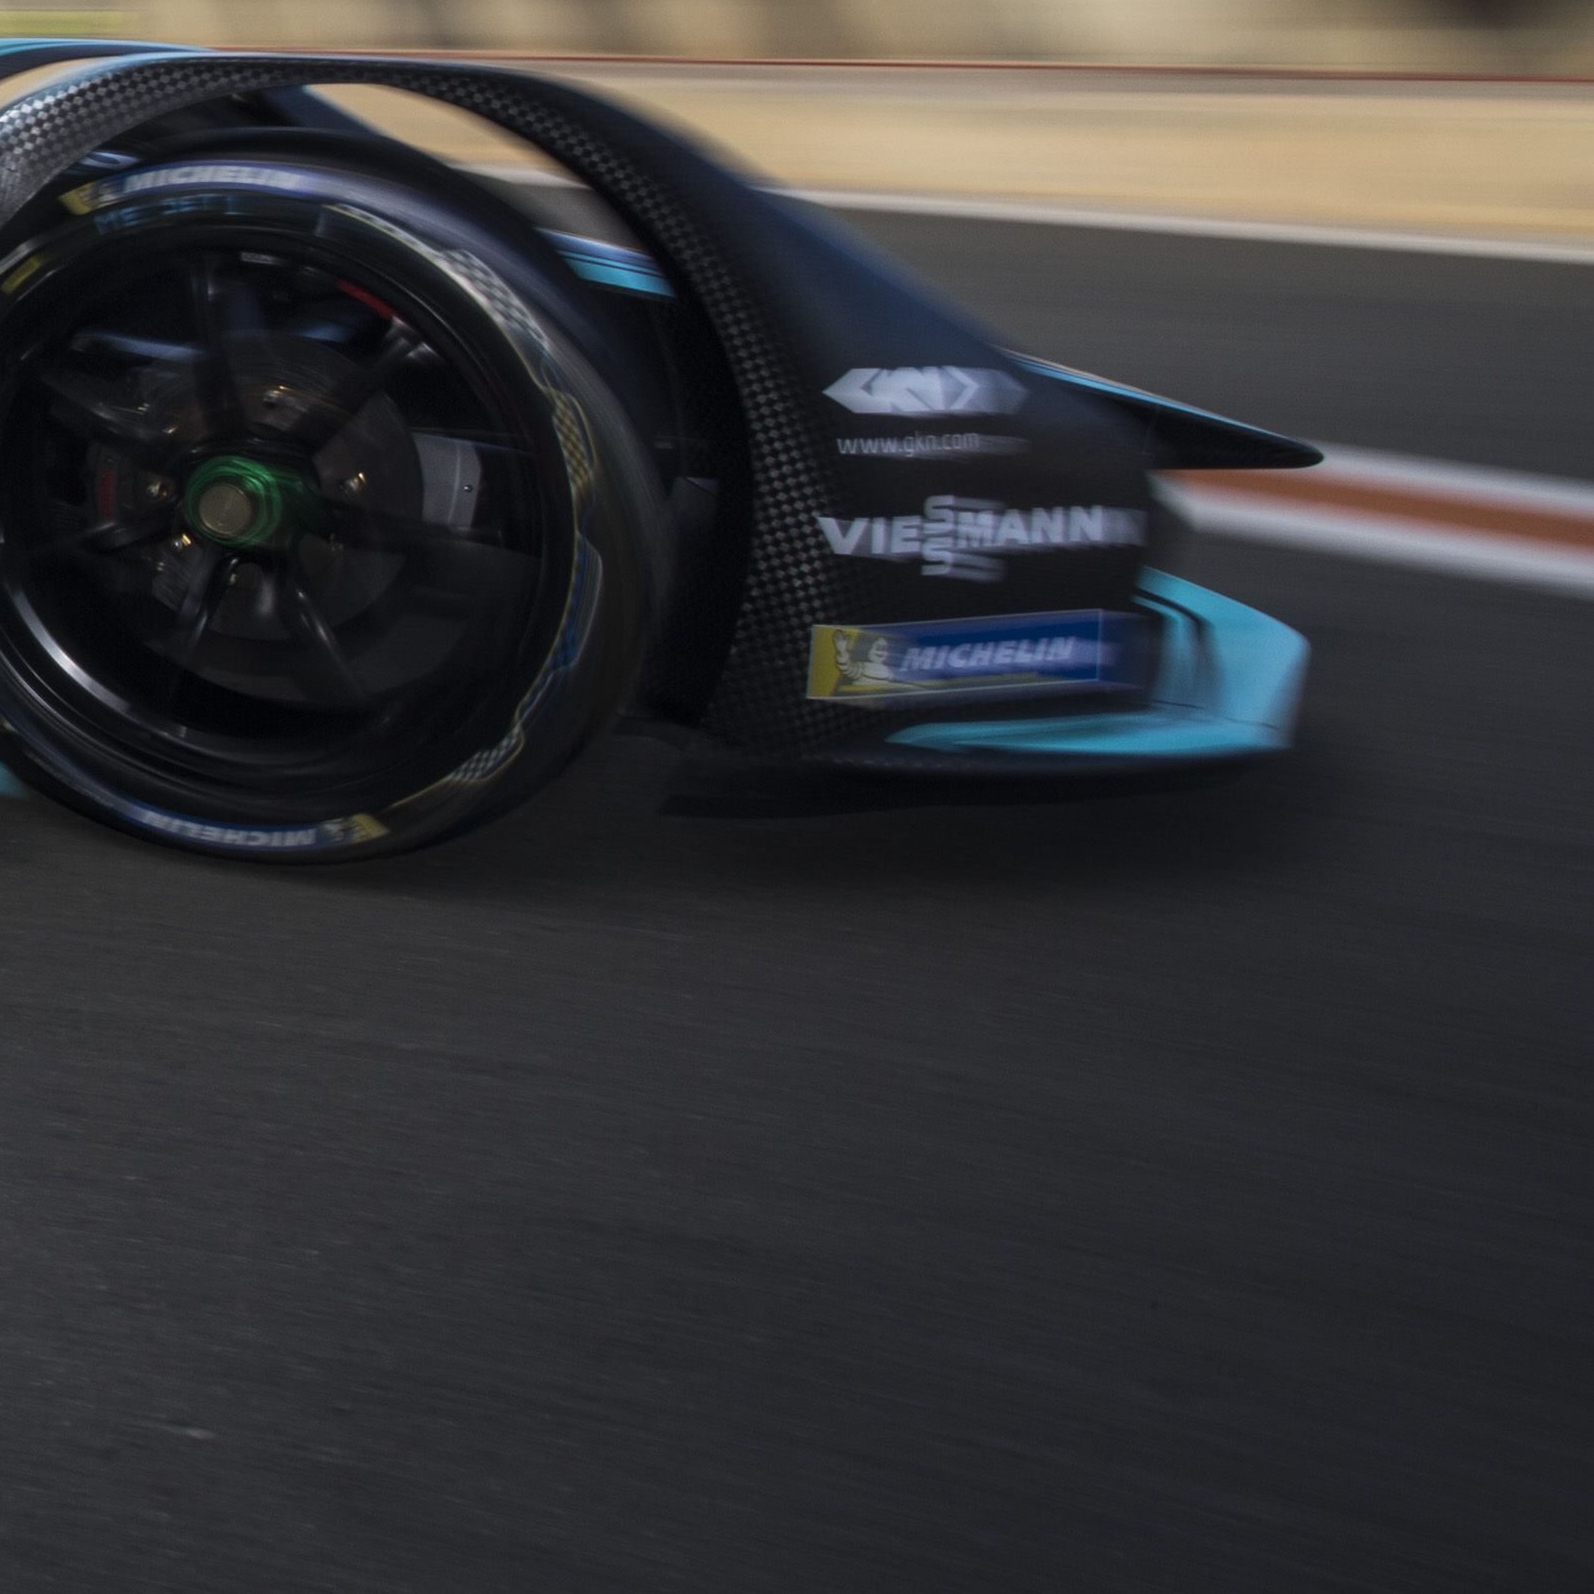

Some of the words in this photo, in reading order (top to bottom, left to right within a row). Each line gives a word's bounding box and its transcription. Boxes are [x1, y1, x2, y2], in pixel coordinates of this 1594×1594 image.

[123, 163, 310, 194] MICHELIN
[836, 431, 981, 457] www.gkn.com
[900, 636, 1077, 671] MICHELIN
[137, 807, 316, 847] MICHELIN
